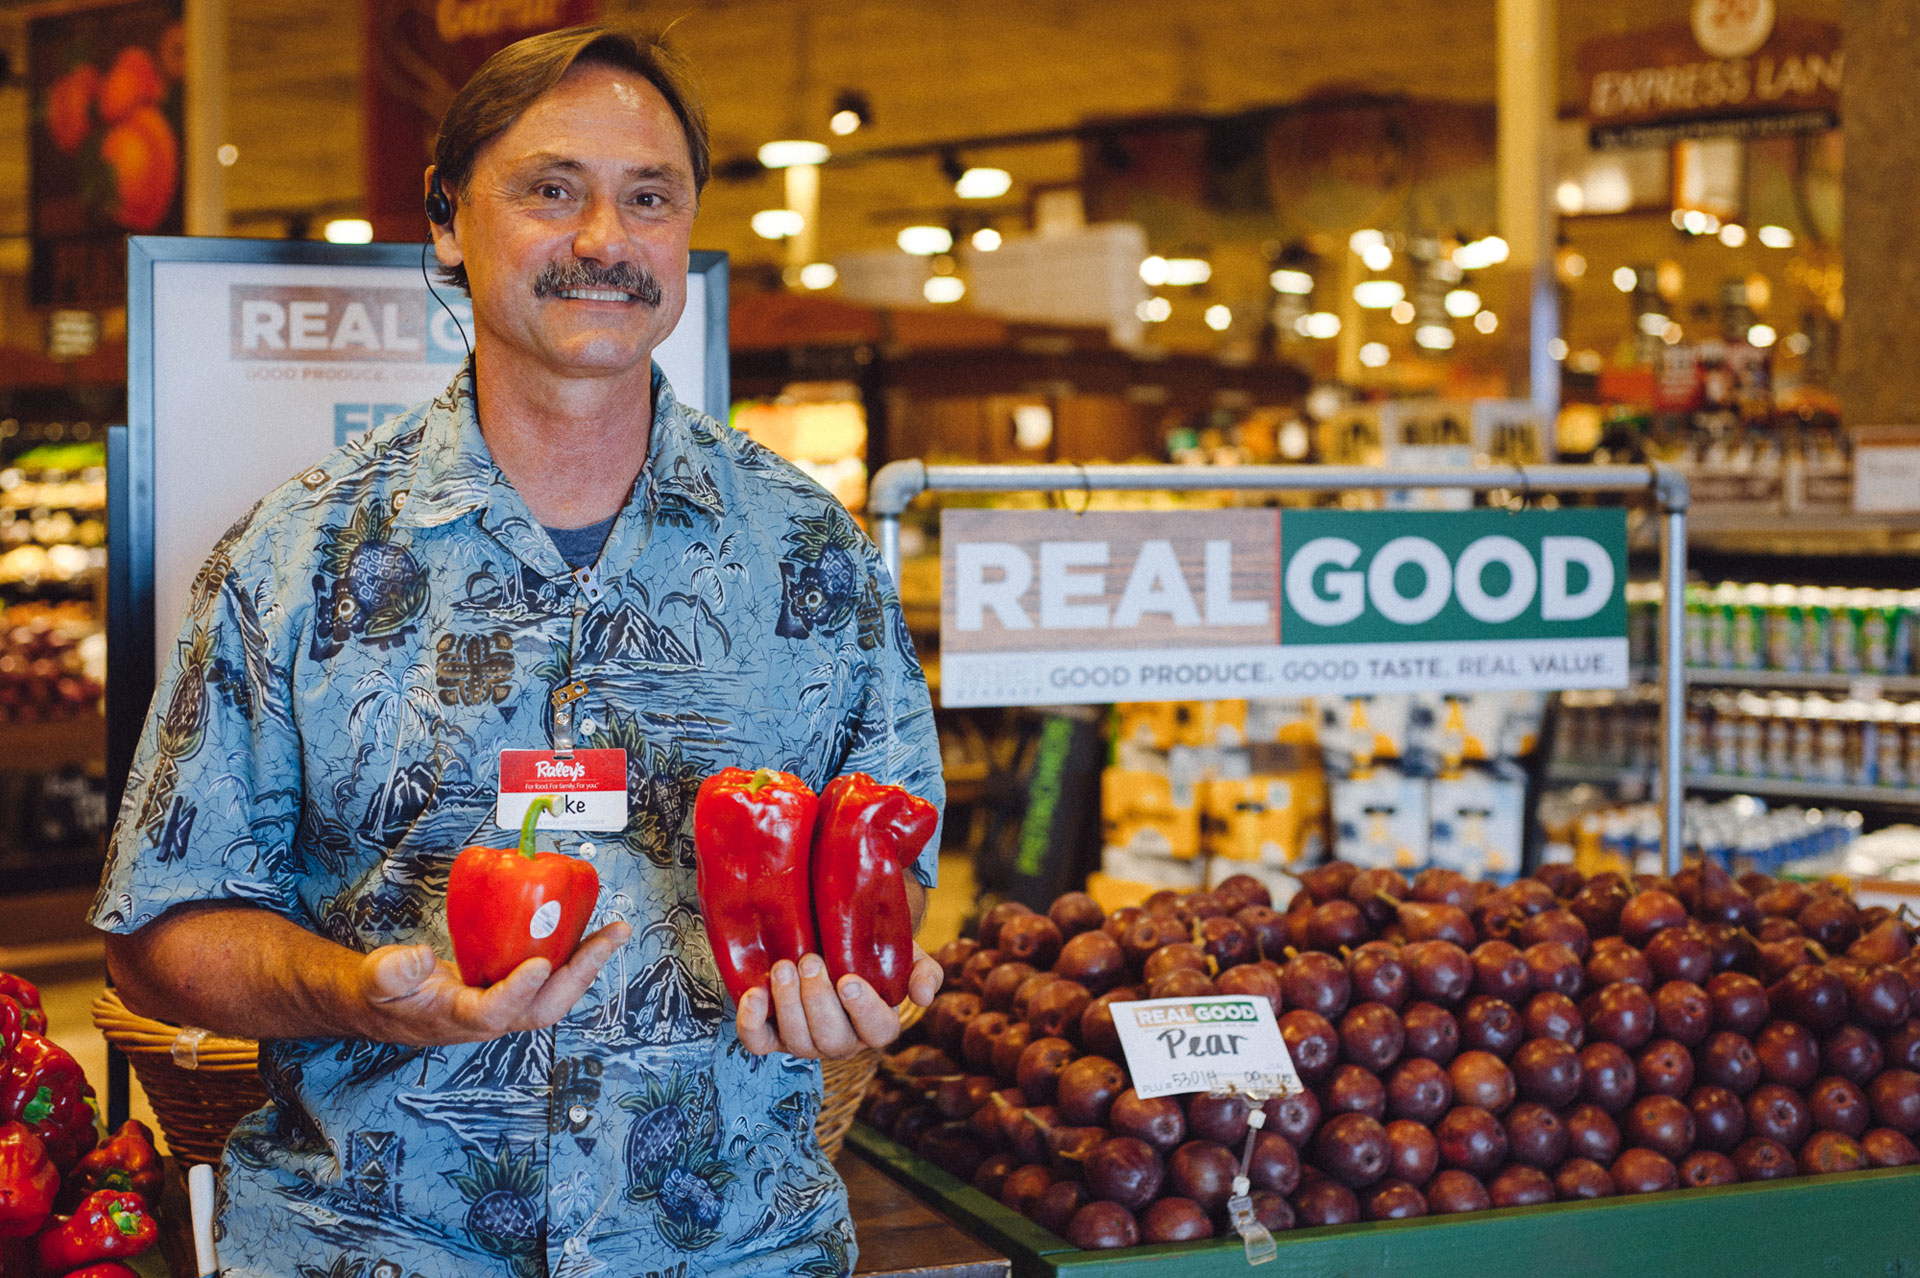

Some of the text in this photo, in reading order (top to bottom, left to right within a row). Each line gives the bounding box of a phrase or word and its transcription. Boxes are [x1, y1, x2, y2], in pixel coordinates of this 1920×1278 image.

[1592, 54, 1844, 117] EXPRESS LAN
[241, 300, 419, 350] REAL
[955, 535, 1615, 631] REAL GOOD
[1050, 665, 1131, 689] GOOD
[1140, 662, 1274, 685] PRODUCE.
[1282, 660, 1359, 682] GOOD
[1369, 657, 1449, 679] TASTE.
[1458, 655, 1520, 677] REAL
[1530, 653, 1613, 676] VALUE.
[535, 760, 586, 782] Raley's
[549, 782, 558, 790] For
[576, 782, 585, 790] For
[1137, 1004, 1256, 1025] REAL GOOD
[1157, 1029, 1248, 1059] Pear
